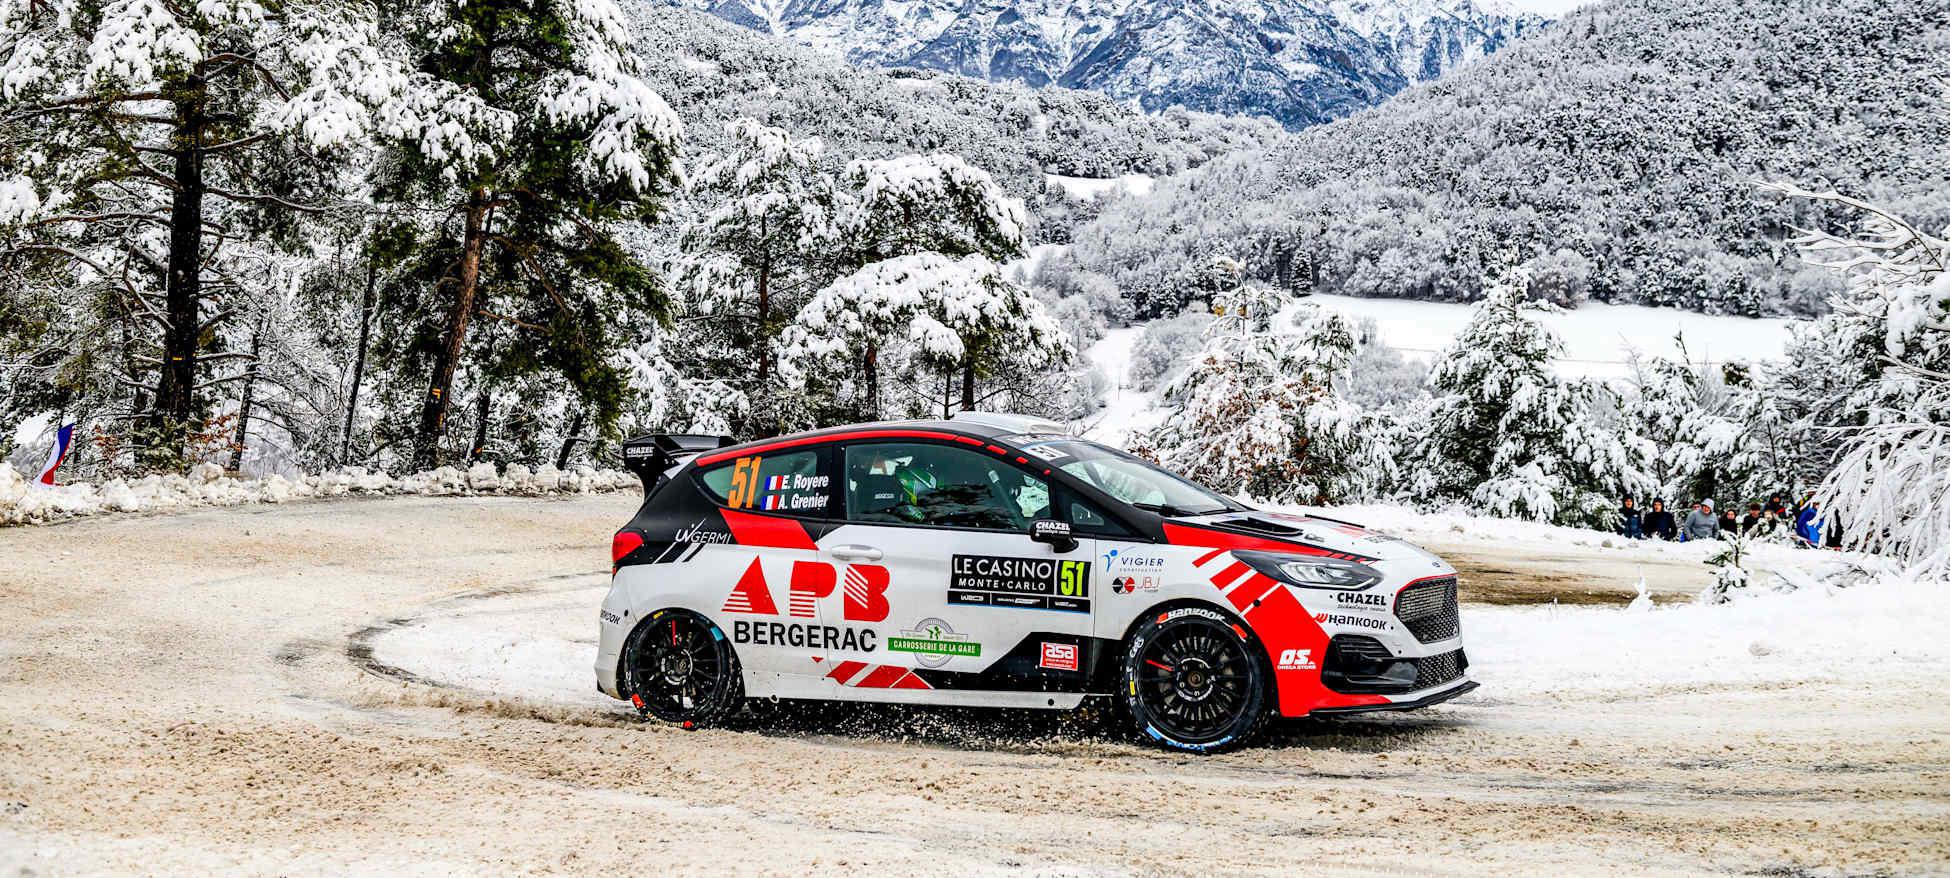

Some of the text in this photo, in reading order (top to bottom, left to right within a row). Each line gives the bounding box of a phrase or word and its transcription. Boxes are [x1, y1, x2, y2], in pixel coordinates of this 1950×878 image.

[728, 456, 762, 508] 51
[781, 474, 829, 491] E. Royere
[777, 492, 829, 509] A. Grenier
[1035, 521, 1070, 530] CHAZEL
[954, 558, 1052, 579] LE CASINO
[1121, 557, 1164, 566] VIGIER
[958, 578, 1046, 591] MONTE CARLO
[1060, 561, 1085, 596] 51
[721, 554, 890, 622] APB
[1337, 592, 1386, 606] CHAZEL
[734, 620, 877, 652] BERGERAC
[893, 640, 976, 654] CARROSSERIE DE LA GARE
